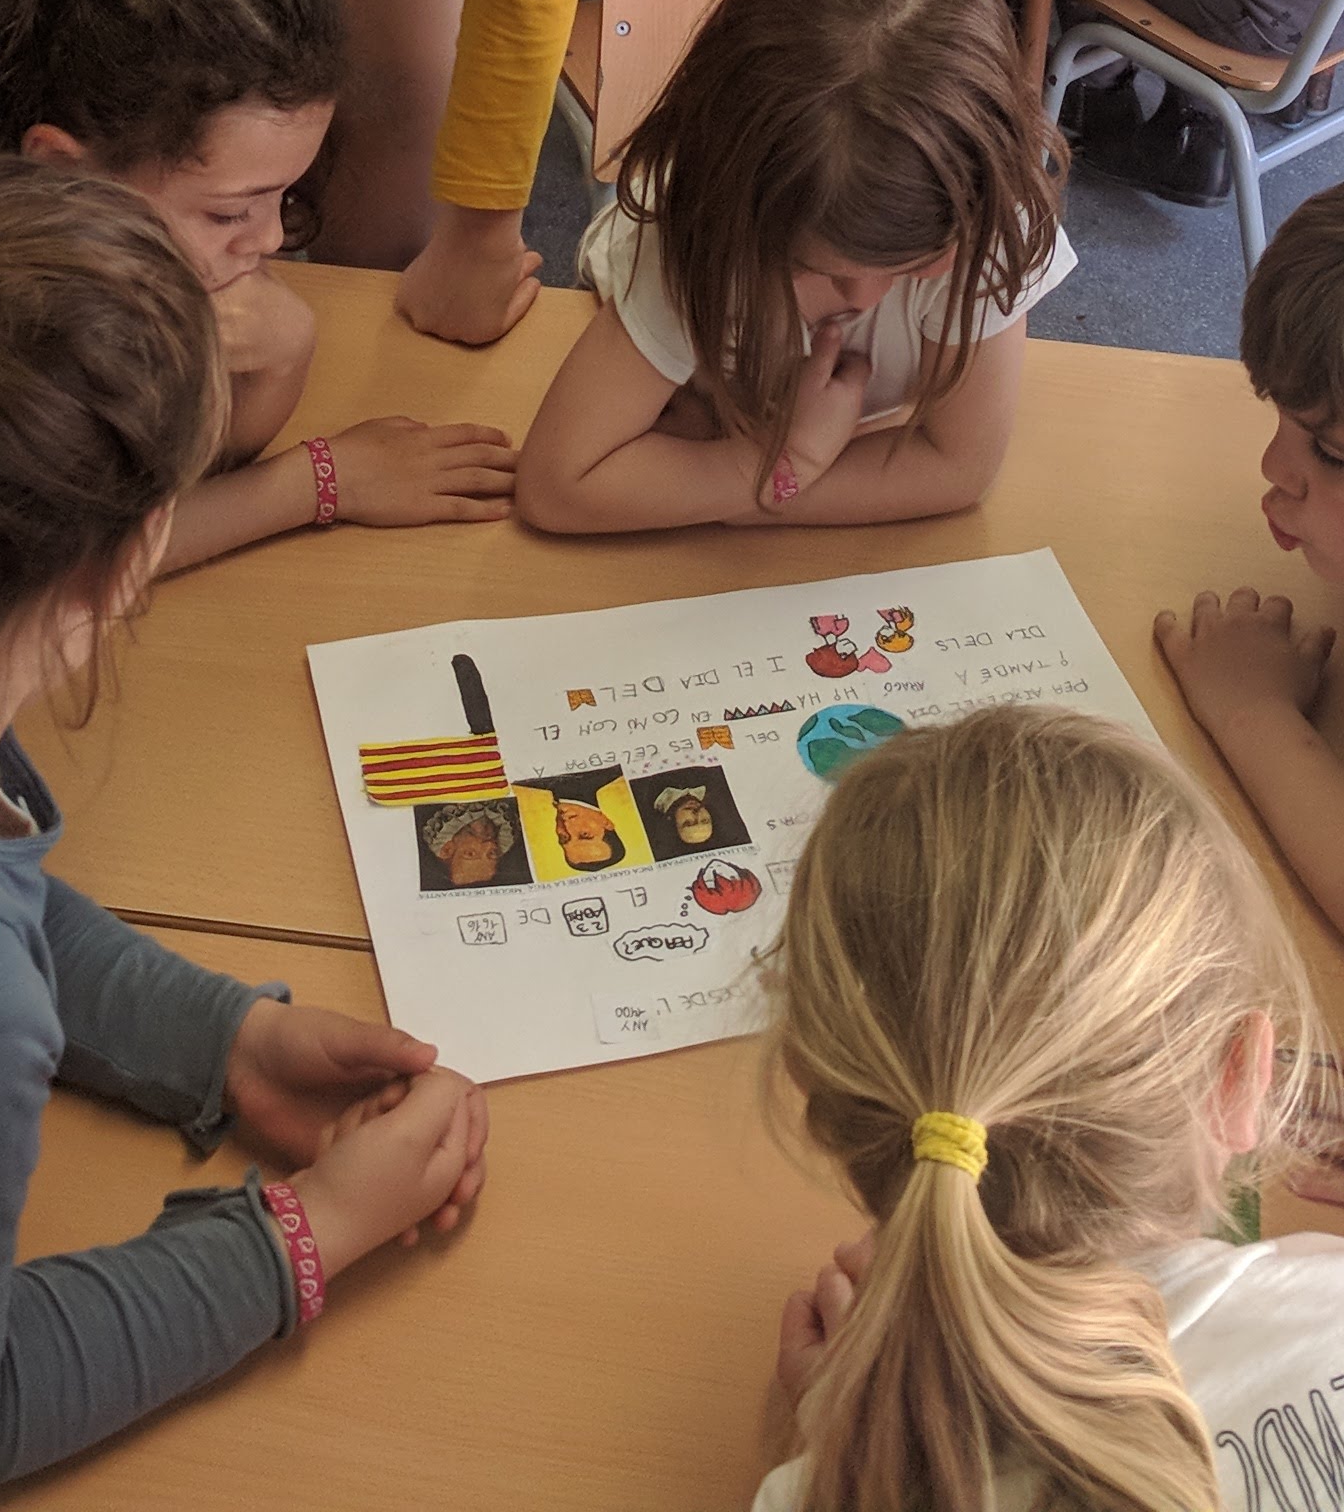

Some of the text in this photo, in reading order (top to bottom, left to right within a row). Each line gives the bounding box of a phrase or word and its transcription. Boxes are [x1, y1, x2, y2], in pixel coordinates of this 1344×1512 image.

[1005, 625, 1046, 642] DIA
[934, 632, 993, 653] DELS
[732, 661, 754, 678] EL
[679, 668, 720, 690] DIA
[599, 675, 665, 701] DEL
[691, 710, 710, 723] EN
[906, 705, 942, 719] DIA
[534, 723, 561, 741] EL
[745, 730, 780, 744] DEL
[668, 737, 694, 751] ES
[616, 886, 648, 908] EL
[515, 906, 552, 926] DE
[619, 1020, 649, 1032] ANY
